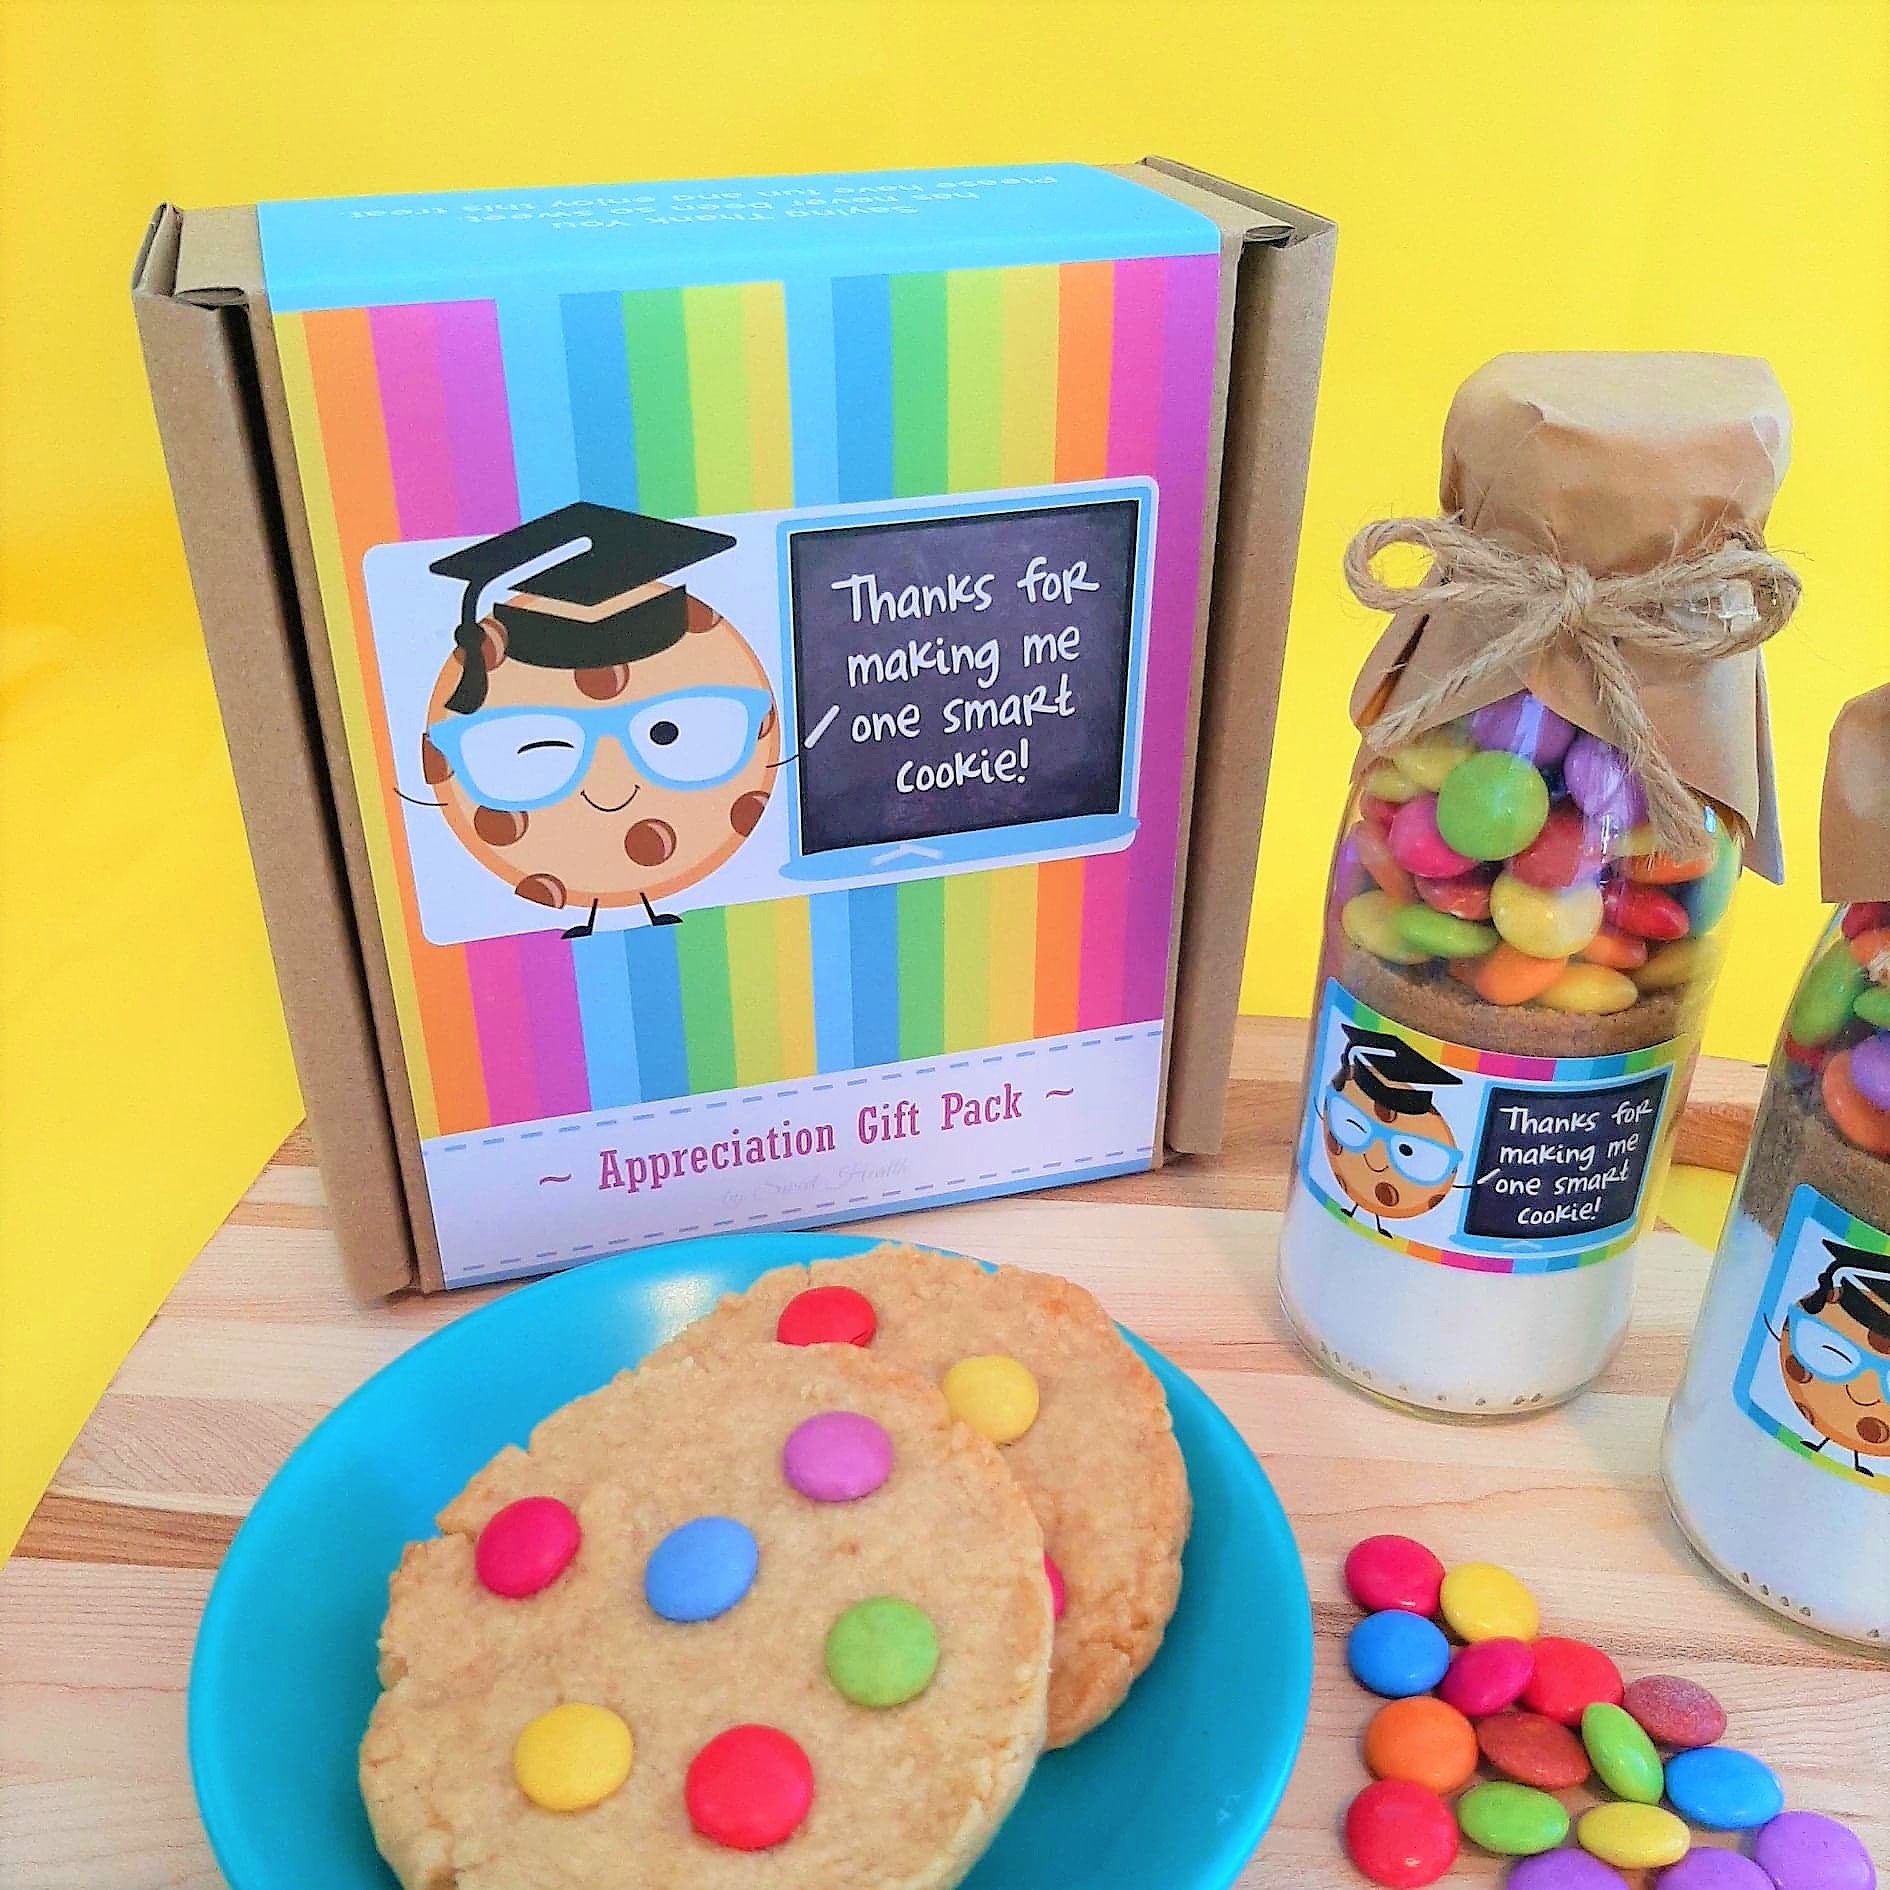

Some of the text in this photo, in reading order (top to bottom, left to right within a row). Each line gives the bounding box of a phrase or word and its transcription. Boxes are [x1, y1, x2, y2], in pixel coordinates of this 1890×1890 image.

[935, 176, 1058, 189] Please
[756, 188, 821, 198] fun
[833, 184, 924, 194] have
[551, 196, 656, 208] enjoy
[671, 191, 743, 202] and
[791, 195, 899, 207] never
[911, 191, 981, 202] has
[462, 203, 536, 212] this
[608, 206, 656, 215] so
[671, 202, 773, 211] been
[551, 218, 632, 230] You
[644, 212, 775, 225] Thank
[832, 574, 994, 625] Thanks
[848, 626, 1080, 688] making me
[851, 704, 920, 743] one
[1499, 1106, 1600, 1134] Thanks
[598, 1082, 1023, 1194] Appreciation Gift Pack
[1499, 1132, 1639, 1171] making me
[1495, 1176, 1541, 1196] one
